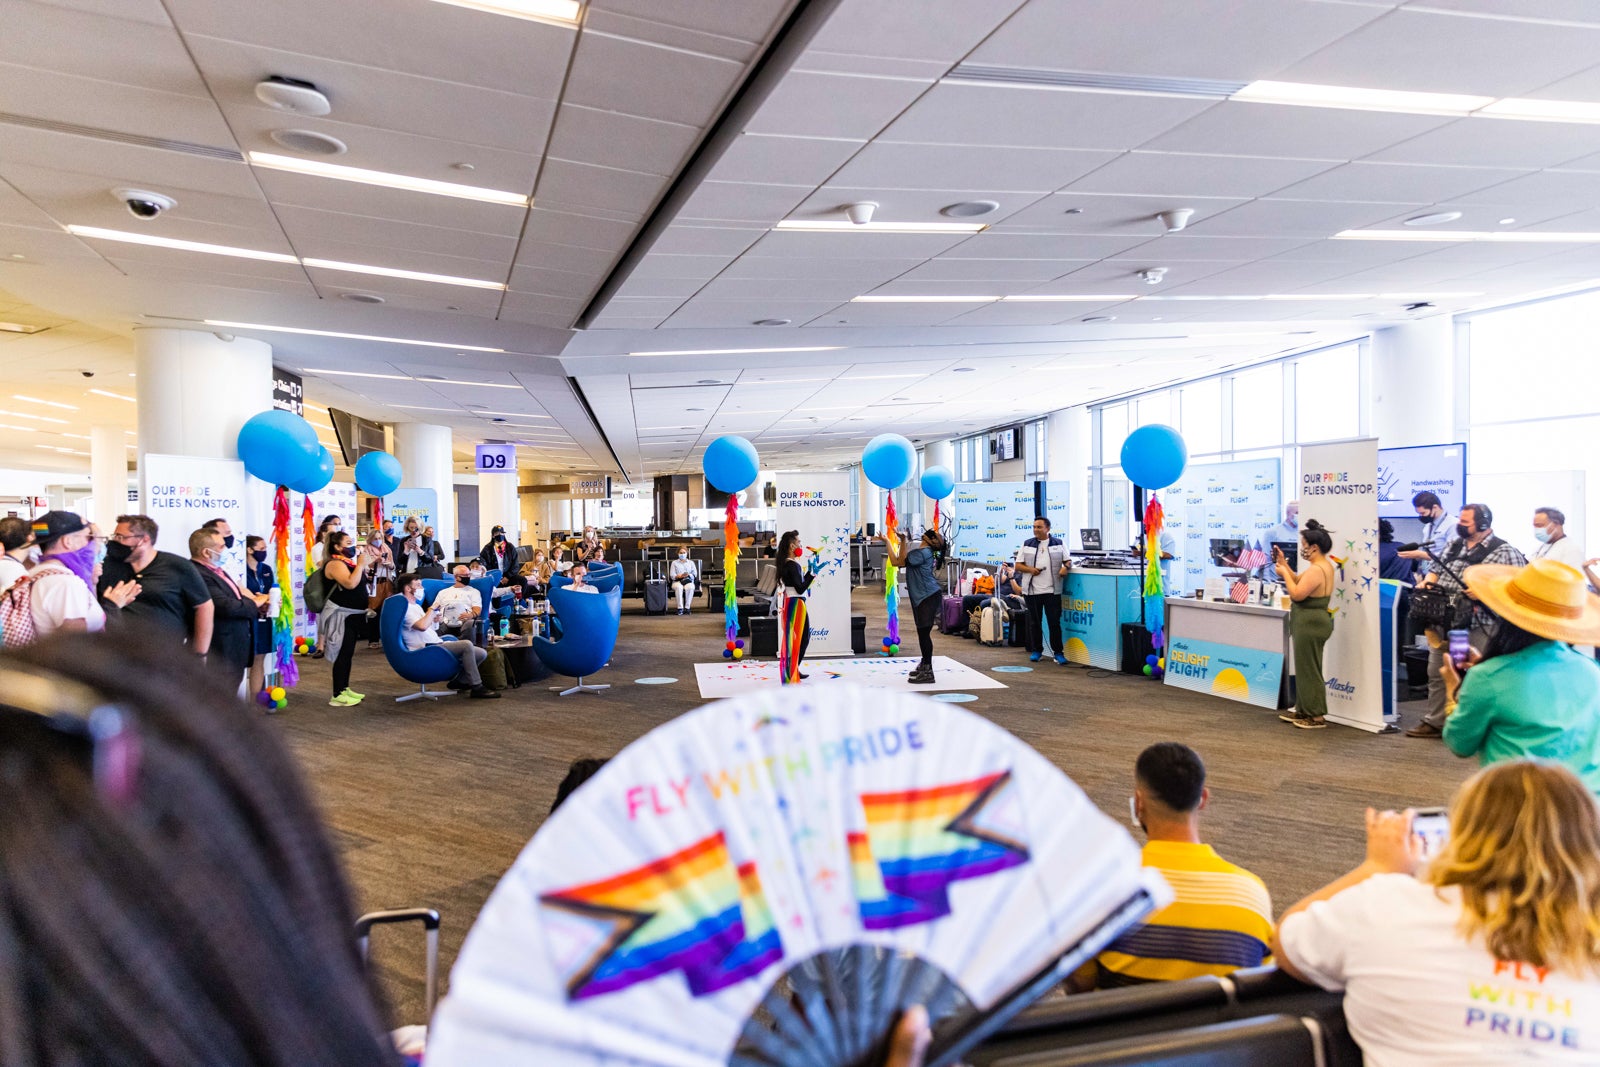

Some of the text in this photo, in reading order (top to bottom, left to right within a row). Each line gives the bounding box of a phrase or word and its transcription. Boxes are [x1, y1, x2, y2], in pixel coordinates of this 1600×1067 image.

[482, 454, 506, 468] D9
[1304, 472, 1348, 483] OUR PRIDE
[152, 486, 176, 495] OUR
[1304, 484, 1374, 495] FLIES NONSTOP.
[152, 498, 240, 508] FLIES NONSTOP.
[1171, 650, 1210, 666] DELIGHT
[1169, 661, 1208, 679] FLIGHT
[1325, 678, 1355, 694] Alaska
[626, 721, 925, 820] FLY WITH PRIDE
[1494, 960, 1549, 984] FLY
[1469, 981, 1572, 1018] WITH
[1465, 1007, 1579, 1050] PRIDE
